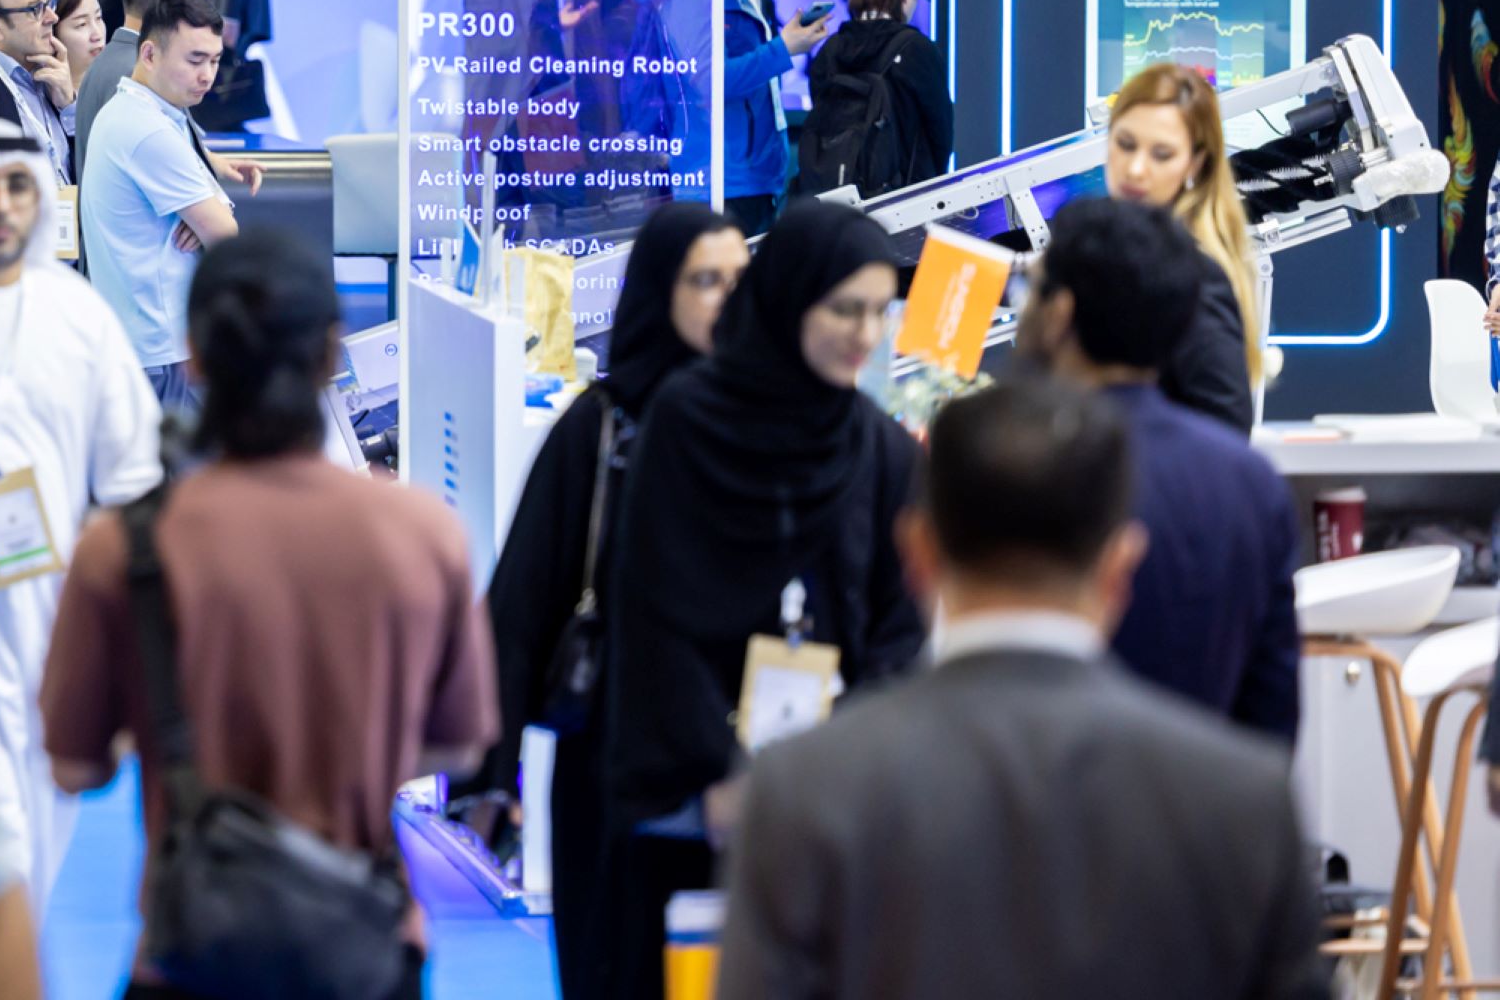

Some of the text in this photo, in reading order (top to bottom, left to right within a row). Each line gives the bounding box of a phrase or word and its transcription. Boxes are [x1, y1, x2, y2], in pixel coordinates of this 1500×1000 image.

[418, 12, 515, 37] PR300
[418, 56, 698, 78] PV Railed Cleaning Robot
[417, 98, 581, 119] Twistable body
[418, 135, 684, 156] Smart obstacle crossing
[417, 170, 705, 190] Active posture adjustment
[418, 204, 532, 224] Windpoof
